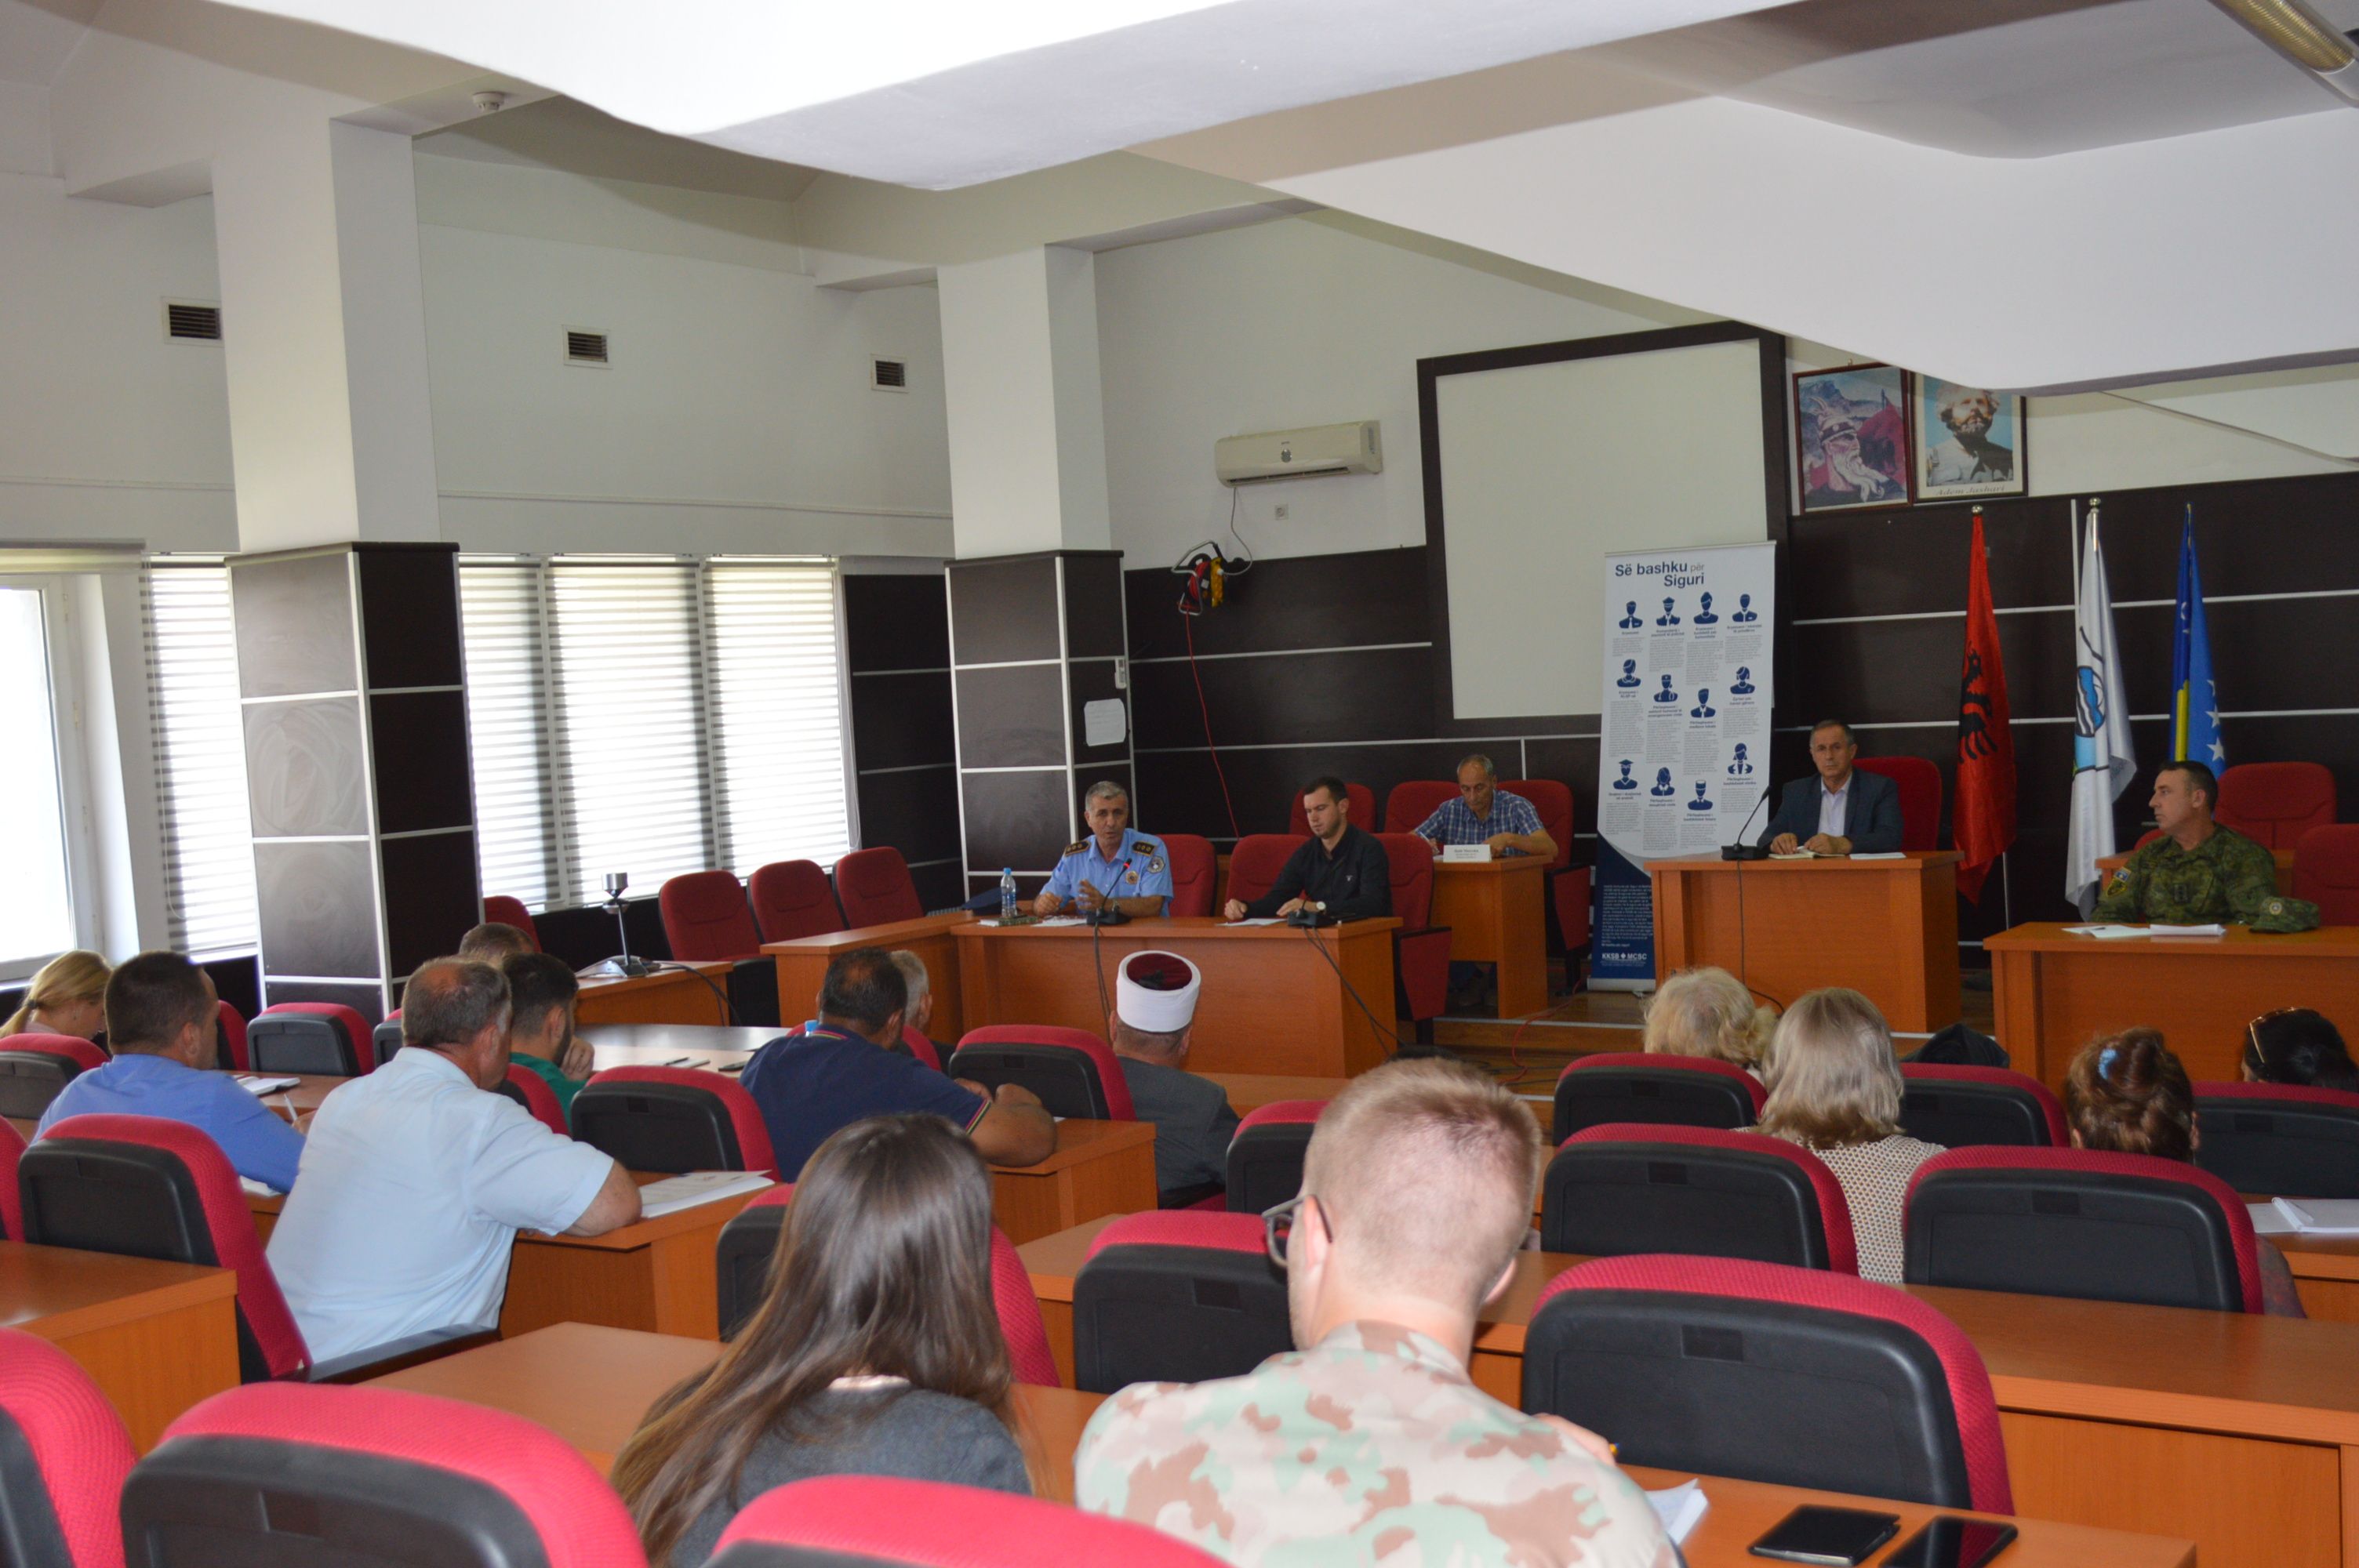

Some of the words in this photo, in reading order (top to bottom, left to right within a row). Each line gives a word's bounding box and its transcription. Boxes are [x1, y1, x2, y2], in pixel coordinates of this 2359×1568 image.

[1615, 564, 1632, 576] Së
[1637, 561, 1687, 575] bashku
[1690, 563, 1705, 573] për
[1664, 572, 1704, 589] Siguri
